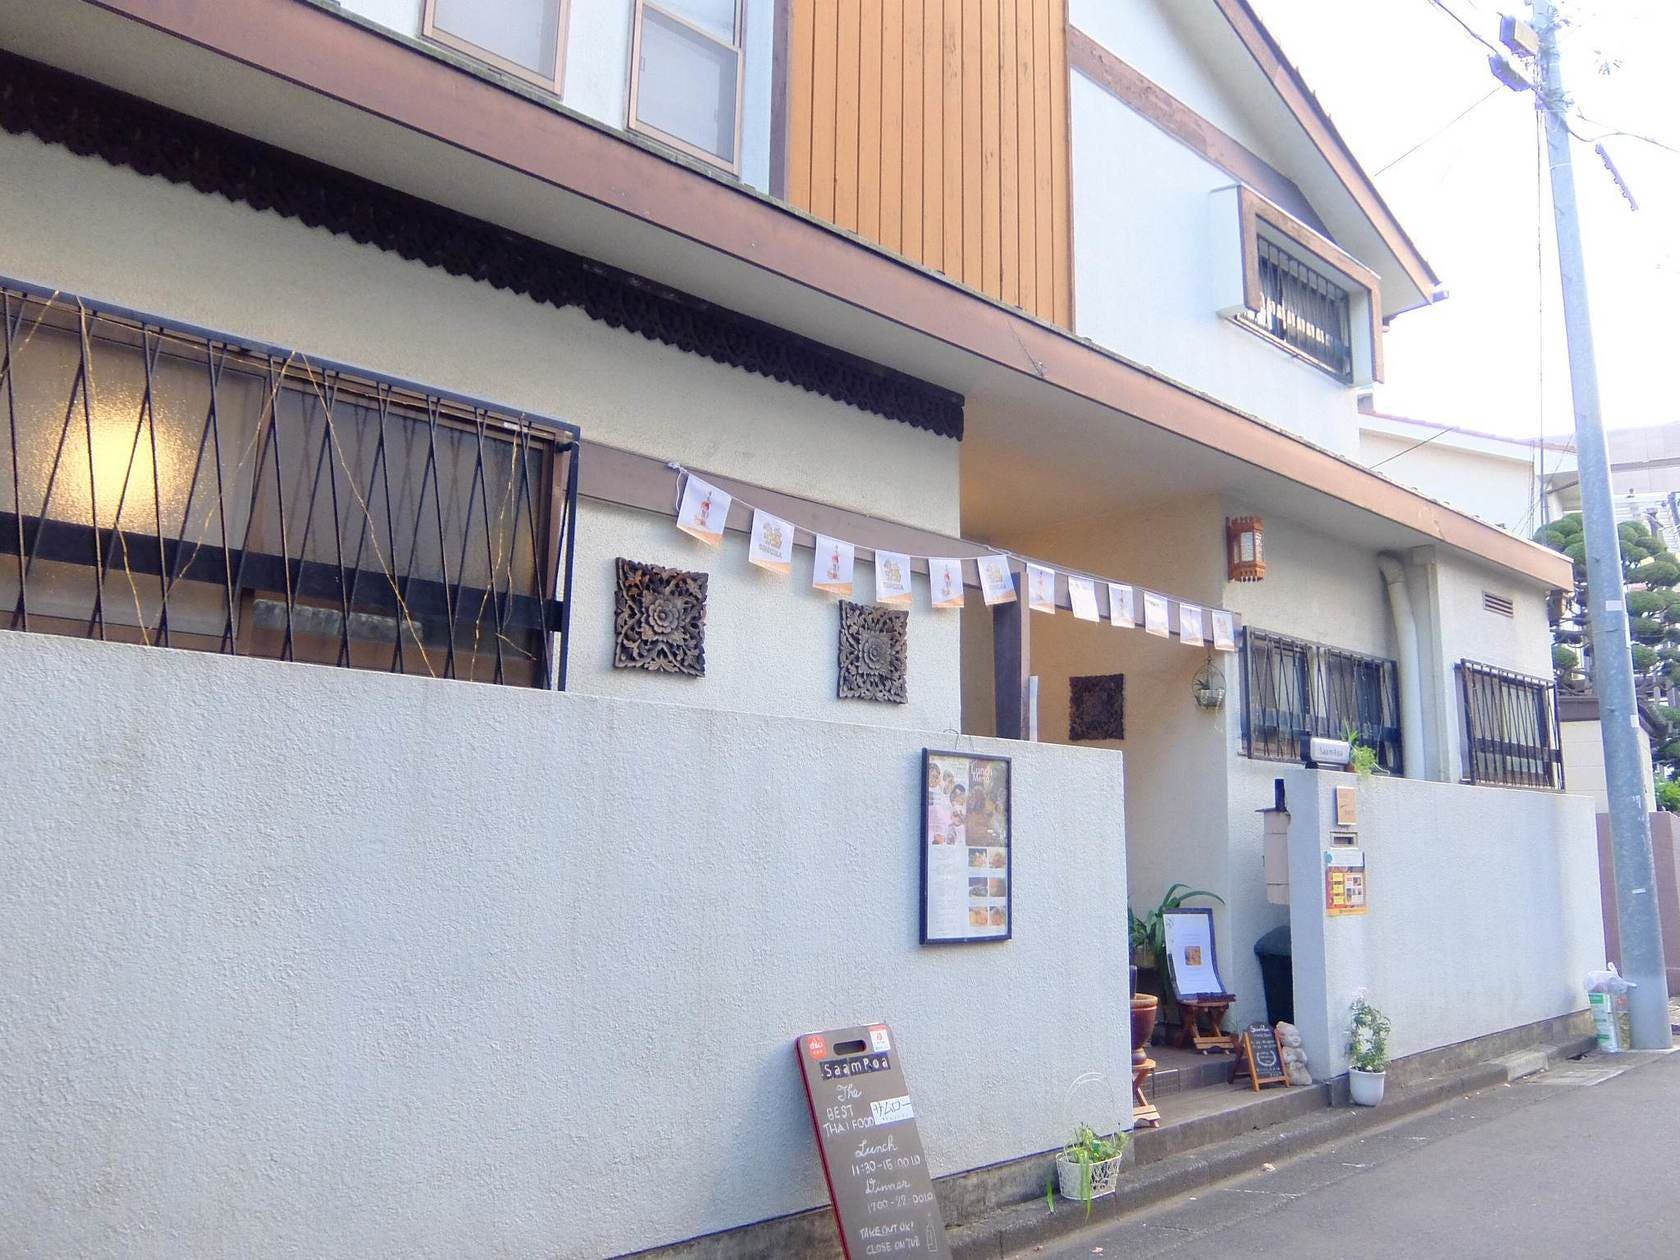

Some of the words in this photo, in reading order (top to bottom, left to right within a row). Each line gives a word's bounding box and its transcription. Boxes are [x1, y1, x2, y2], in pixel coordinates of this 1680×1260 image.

[836, 1084, 862, 1102] The
[826, 1104, 854, 1121] BEST
[823, 1121, 849, 1137] THAI
[854, 1134, 898, 1158] Lunch
[864, 1178, 910, 1194] Dinner
